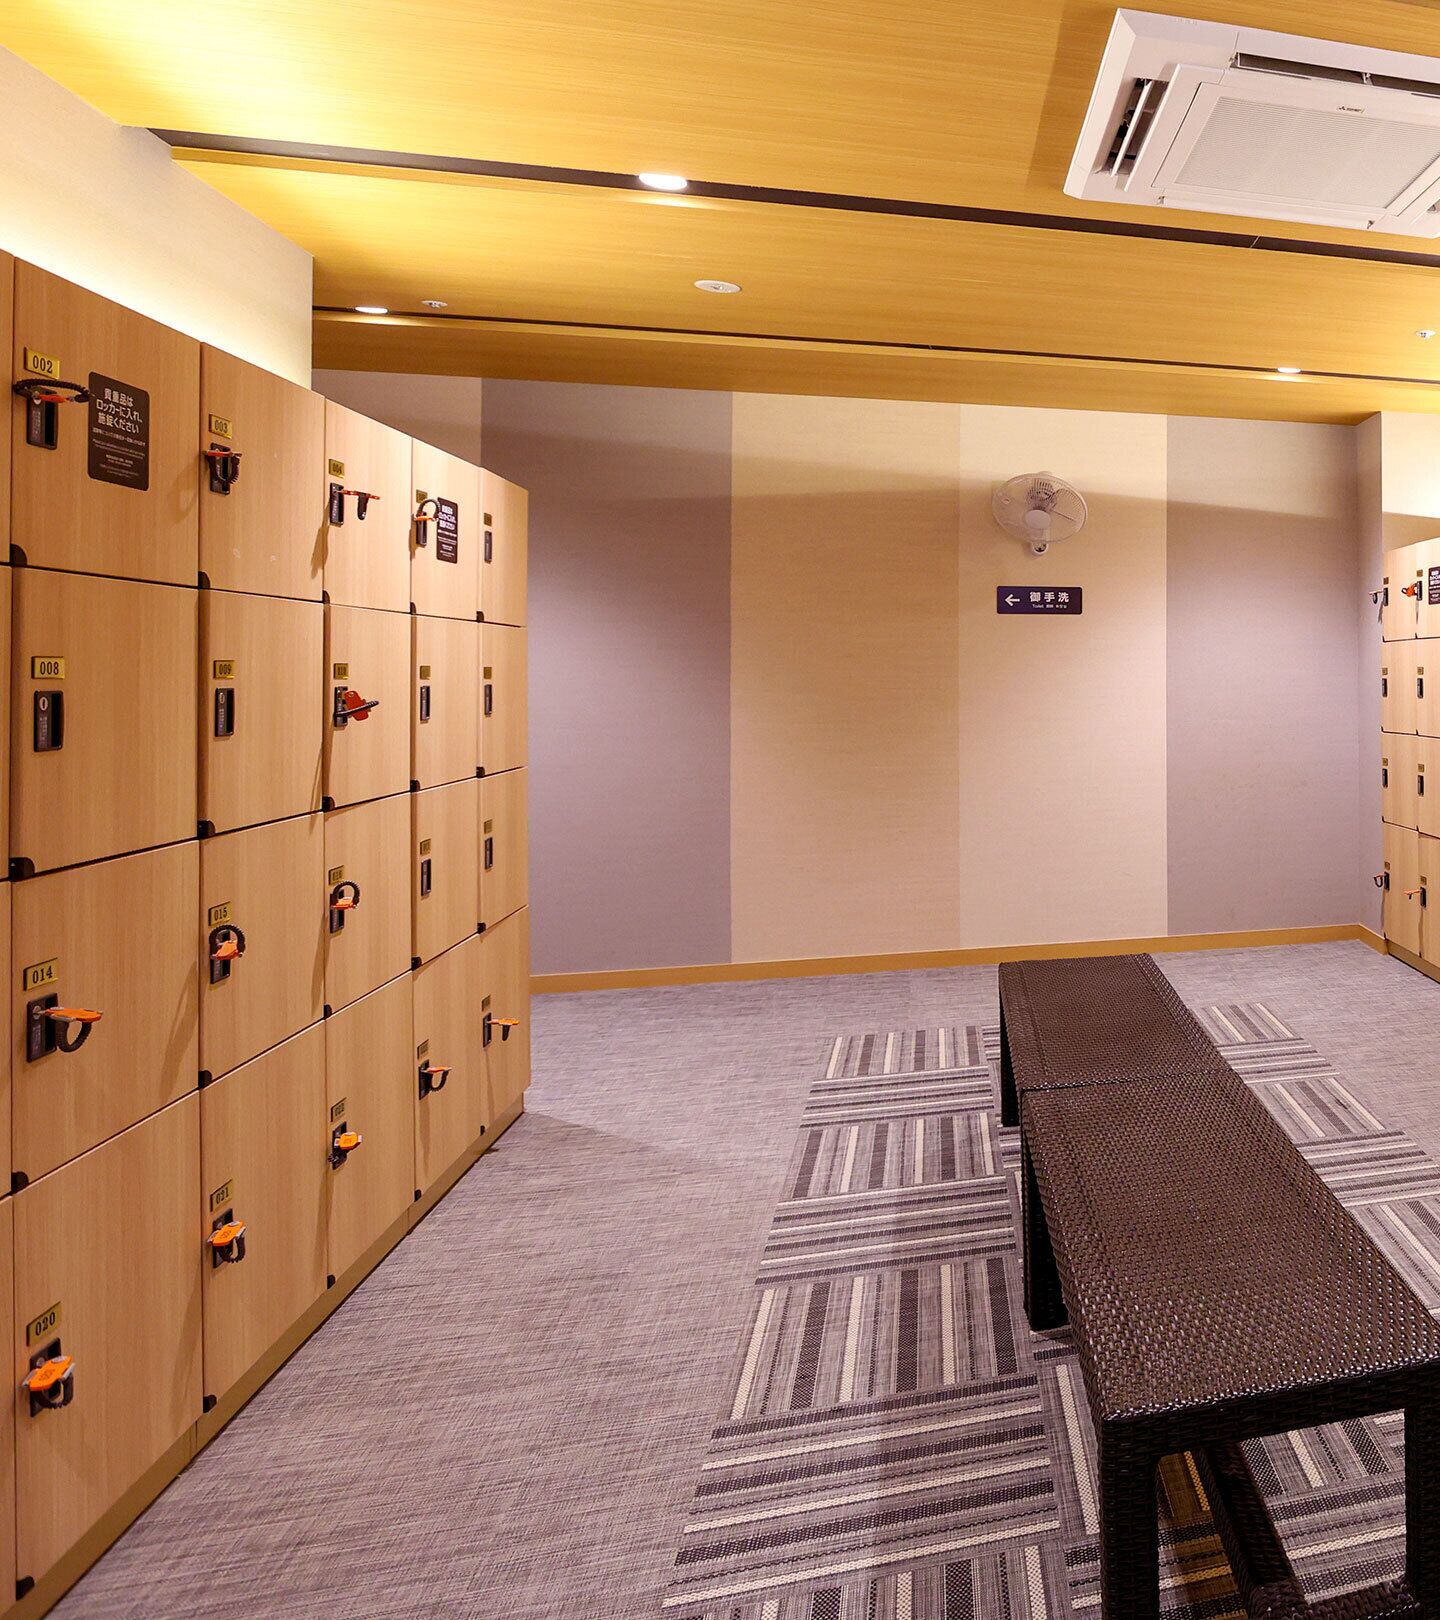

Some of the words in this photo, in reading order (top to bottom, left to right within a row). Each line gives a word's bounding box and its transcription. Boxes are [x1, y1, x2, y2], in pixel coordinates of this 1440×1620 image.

[33, 355, 53, 374] 002
[1029, 591, 1069, 603] 御手洗
[40, 661, 59, 675] 008
[214, 907, 228, 921] 015
[33, 966, 53, 984] 014
[216, 1187, 229, 1204] 021
[36, 1311, 56, 1336] 020
